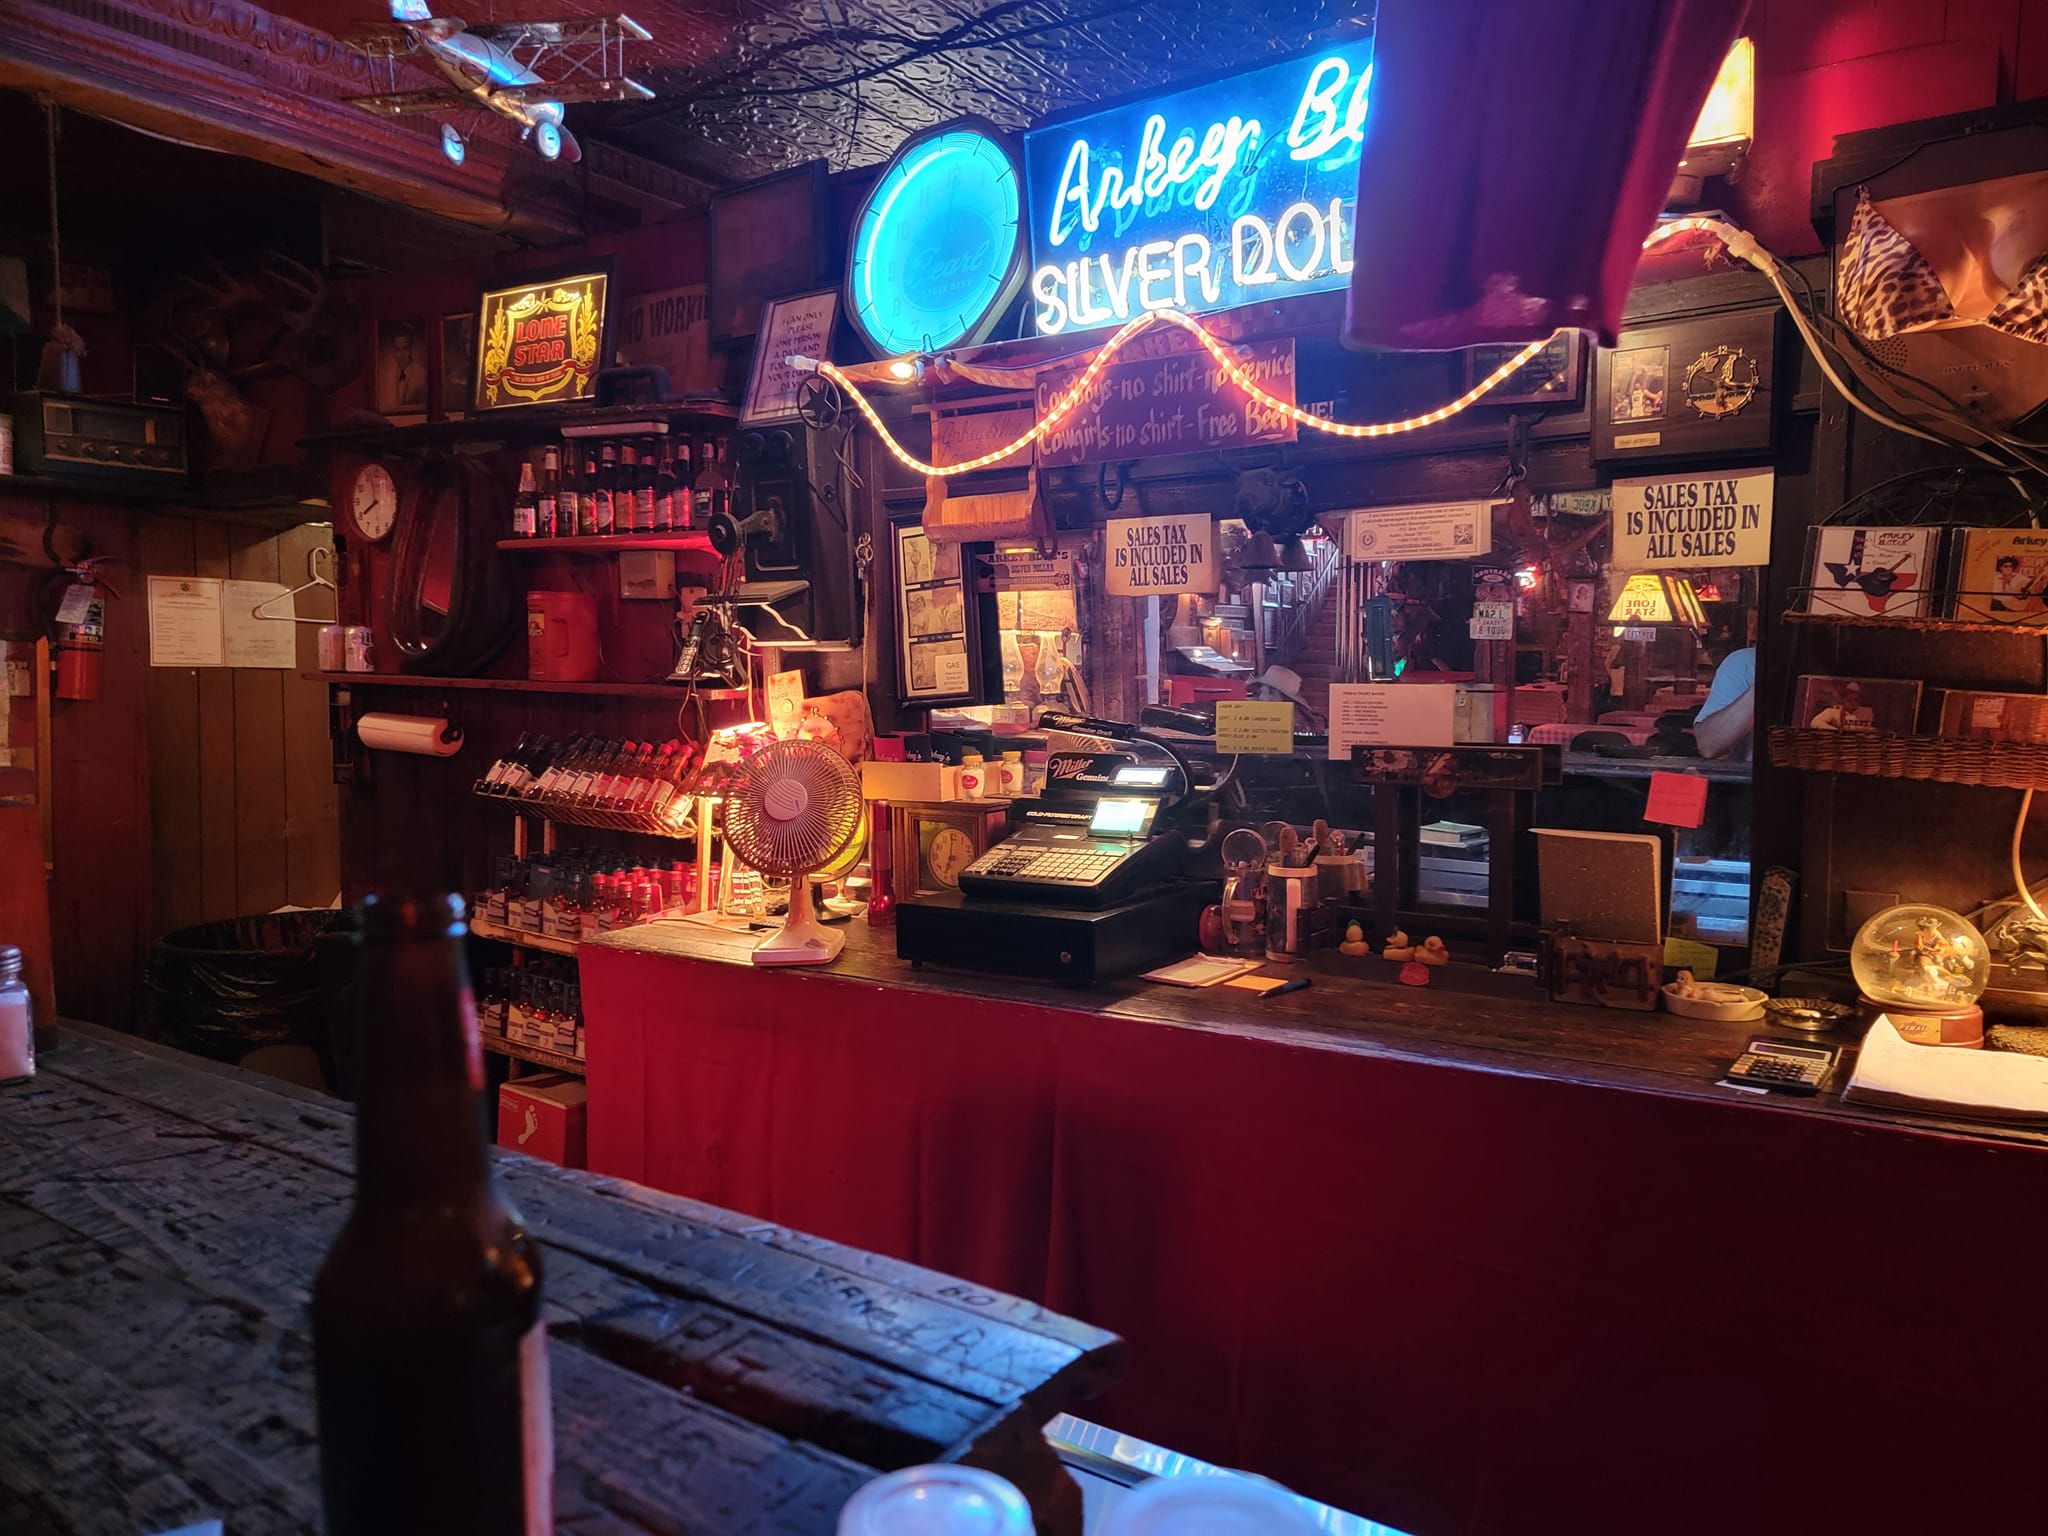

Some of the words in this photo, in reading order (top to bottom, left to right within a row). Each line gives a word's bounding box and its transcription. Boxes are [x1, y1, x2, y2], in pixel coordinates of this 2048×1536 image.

[1050, 113, 1261, 246] Arkey
[1031, 233, 1220, 334] SILVER
[516, 314, 568, 342] LONE
[514, 339, 566, 366] STAR
[1246, 399, 1290, 436] Beer
[1644, 482, 1698, 510] SALES
[1703, 480, 1738, 506] TAX
[1627, 511, 1644, 536] IS
[1648, 506, 1737, 534] INCLUDED
[1741, 504, 1760, 530] IN
[1127, 526, 1160, 547] SALES
[1162, 524, 1187, 545] TAX
[1646, 534, 1677, 559] ALL
[1681, 531, 1736, 557] SALES
[2012, 536, 2047, 547] Arkey
[1115, 548, 1127, 567] IS
[1130, 545, 1187, 566] INCLUDED
[1190, 544, 1203, 564] IN
[1129, 567, 1150, 587] ALL
[1152, 565, 1188, 586] SALES
[946, 661, 960, 669] GAS
[1049, 758, 1094, 780] Miller
[1076, 773, 1110, 782] Genuine
